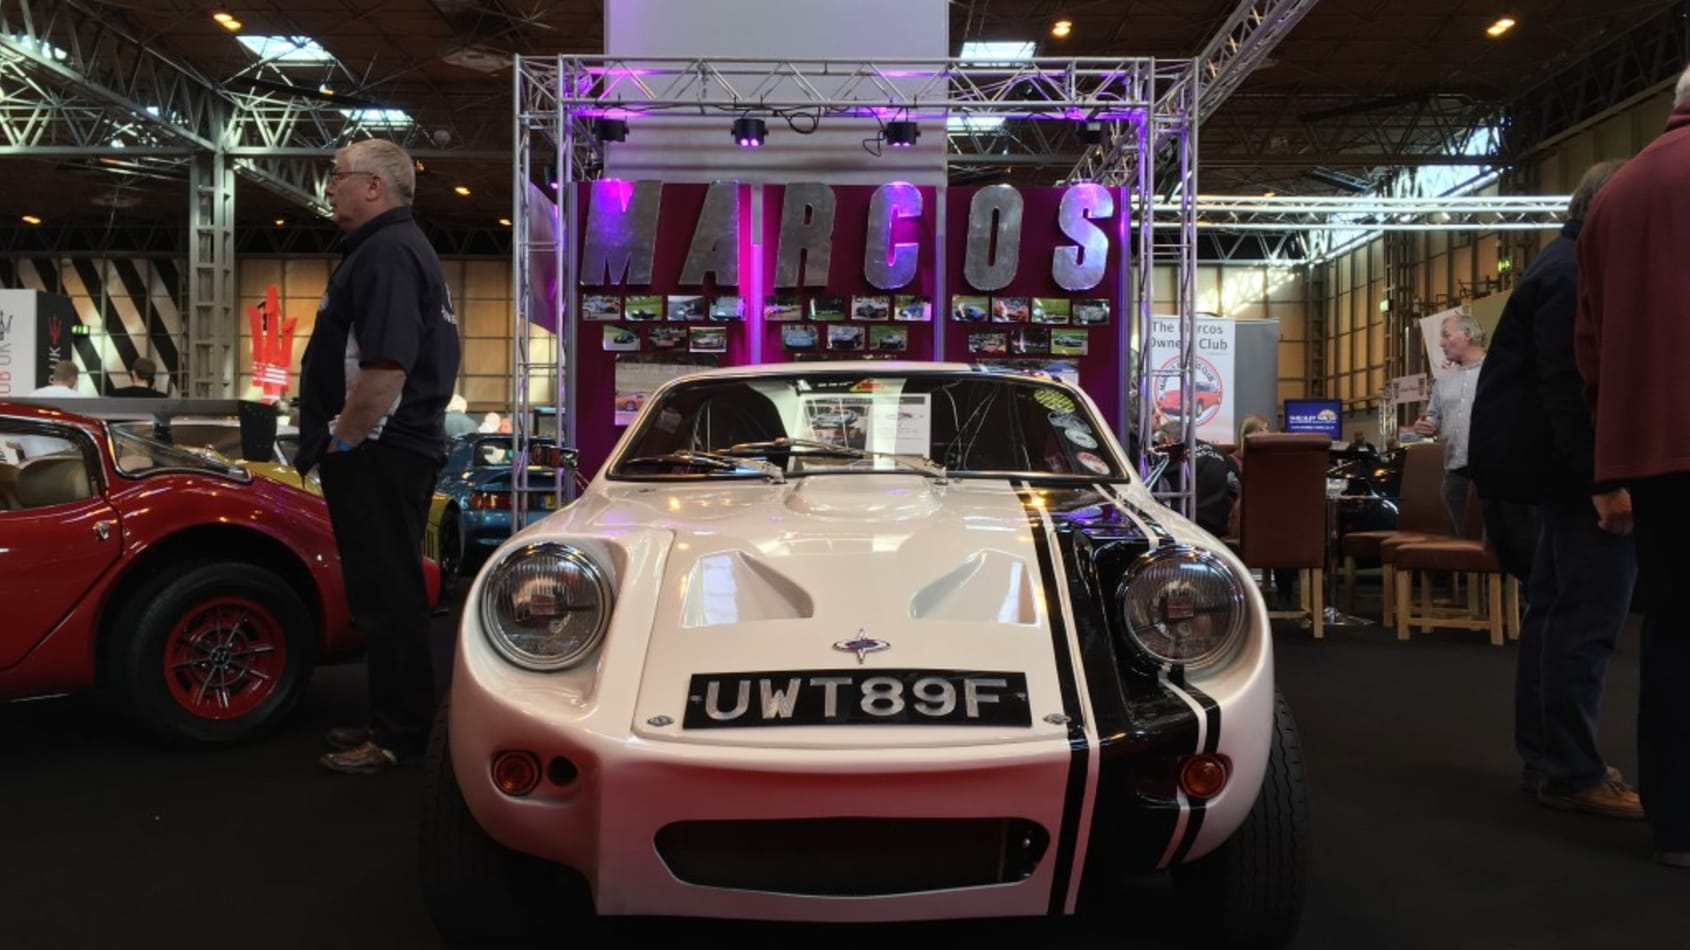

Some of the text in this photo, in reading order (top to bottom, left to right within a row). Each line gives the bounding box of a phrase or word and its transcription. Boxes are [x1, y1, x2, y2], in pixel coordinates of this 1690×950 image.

[580, 178, 1114, 291] MARCOS
[1152, 321, 1175, 333] The
[1198, 338, 1228, 351] Club
[705, 677, 1007, 720] UWT89F
